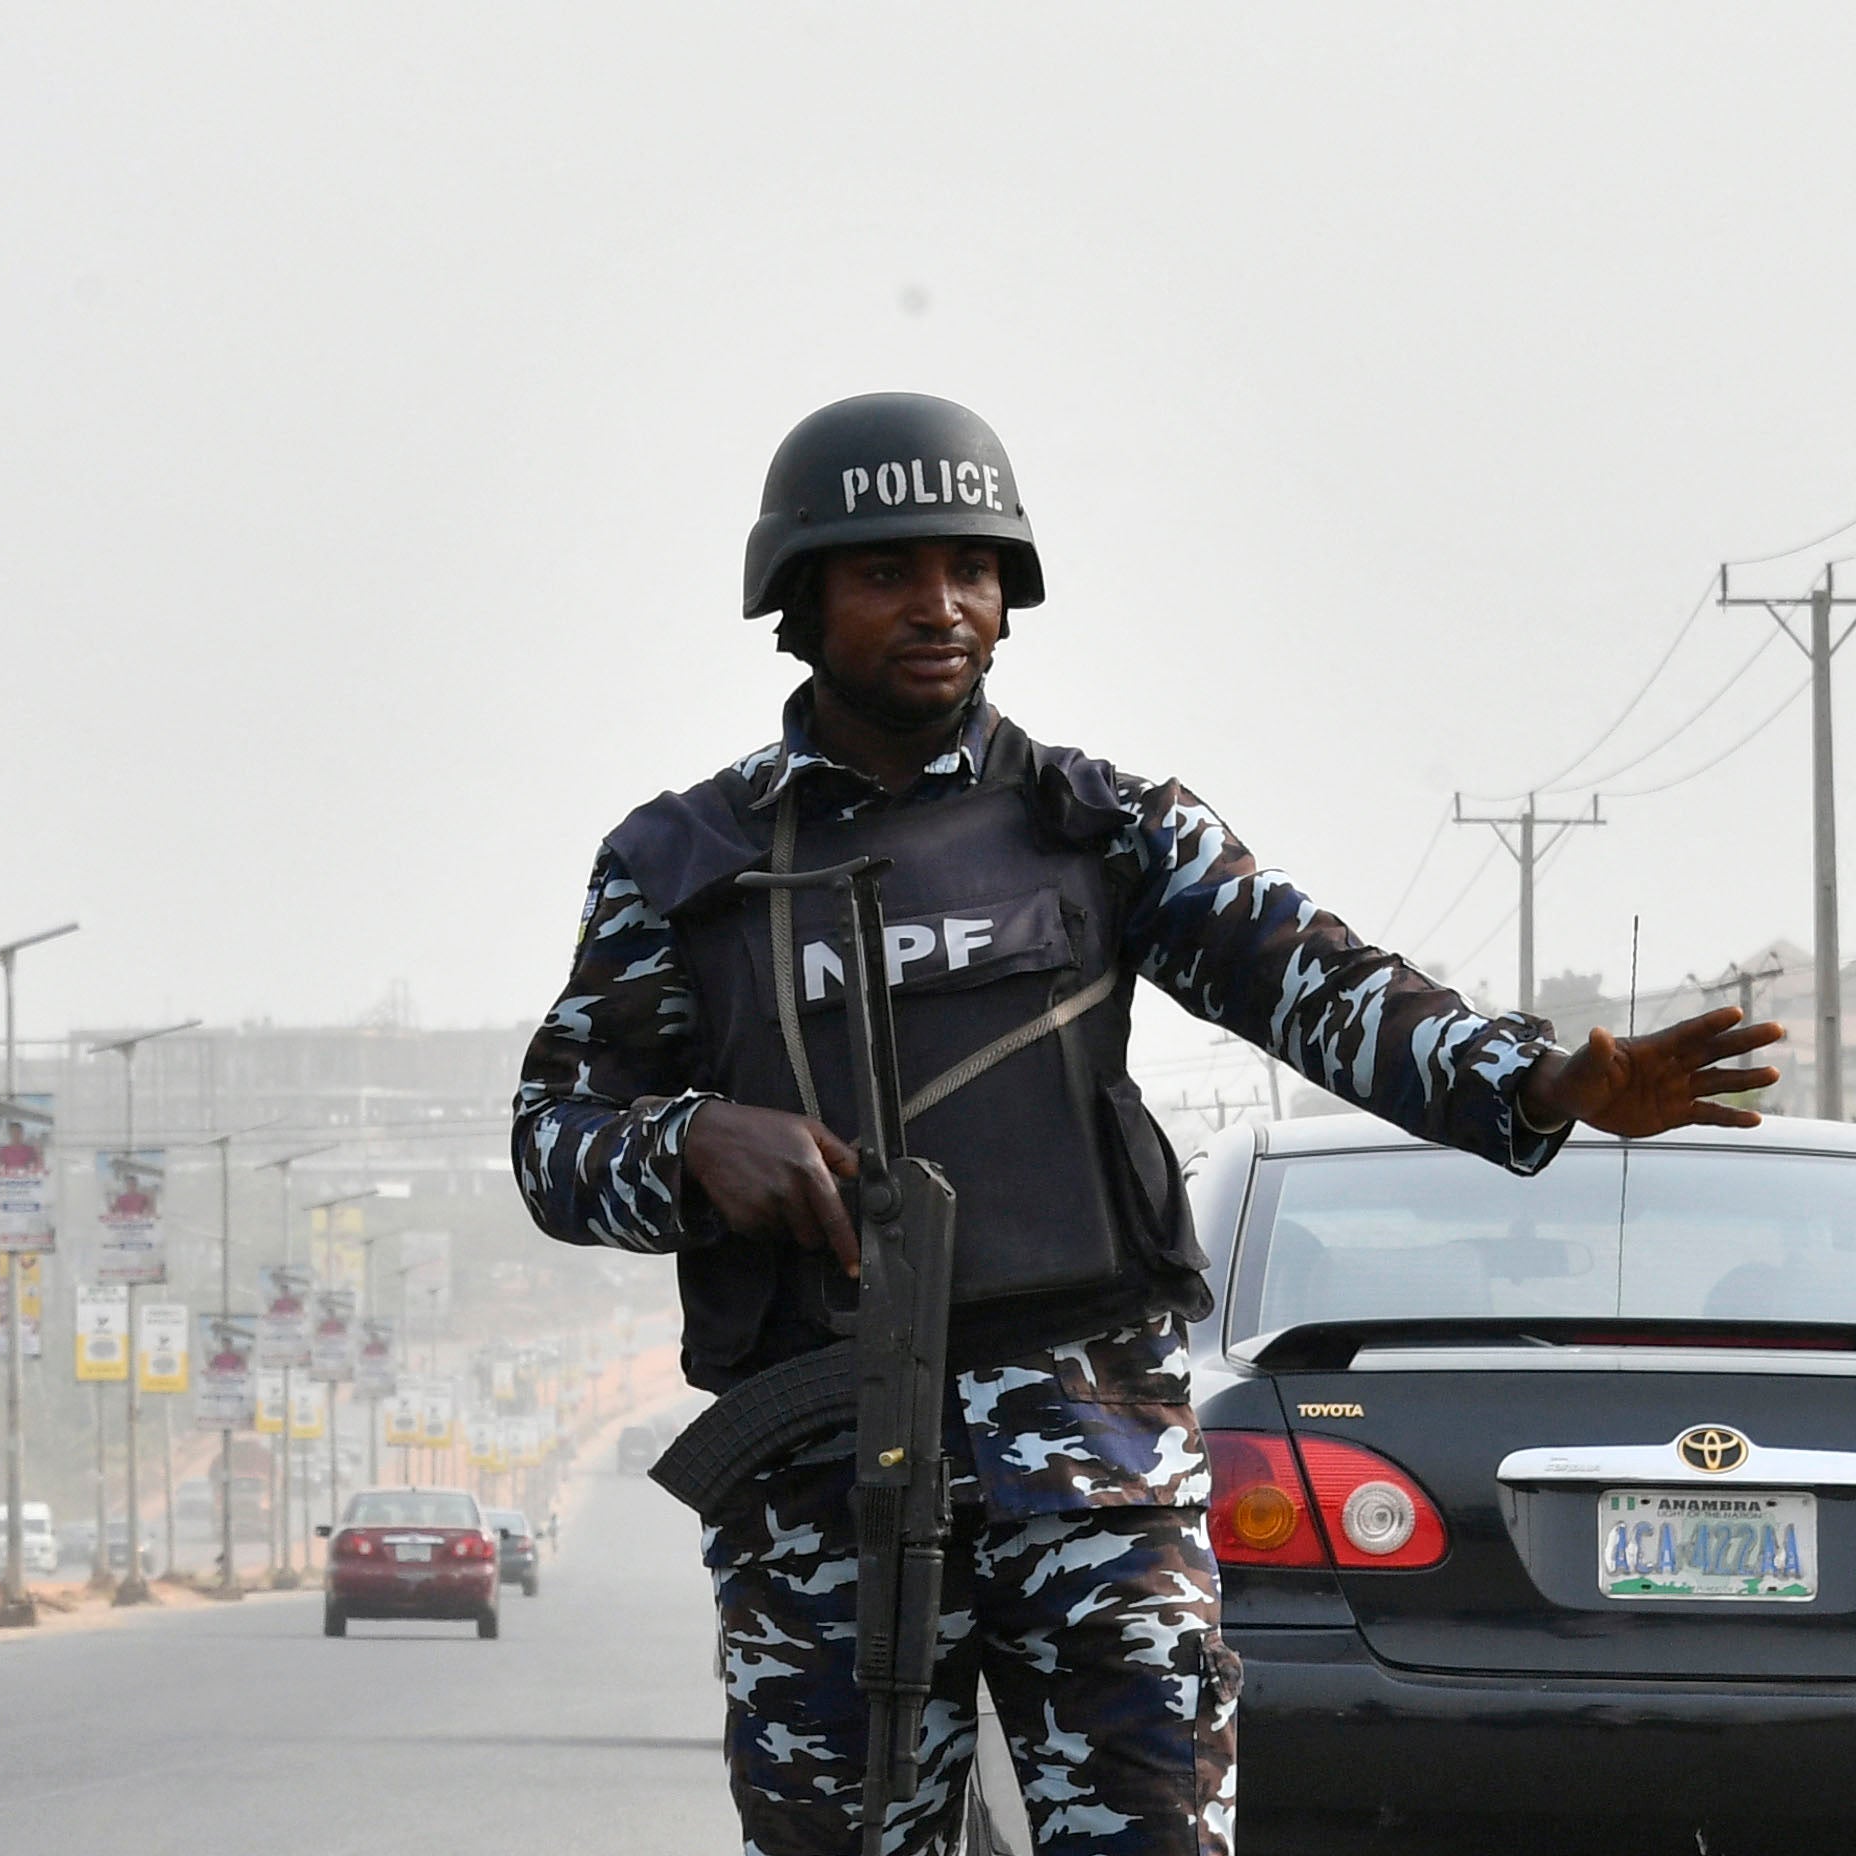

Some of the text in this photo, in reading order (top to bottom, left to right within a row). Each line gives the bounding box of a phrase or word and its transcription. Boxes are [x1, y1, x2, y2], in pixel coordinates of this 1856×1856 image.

[842, 458, 1003, 514] POLICE
[803, 918, 994, 1001] NPF
[1296, 1403, 1364, 1418] TOYOTA
[1658, 1499, 1761, 1512] ANAMBRA
